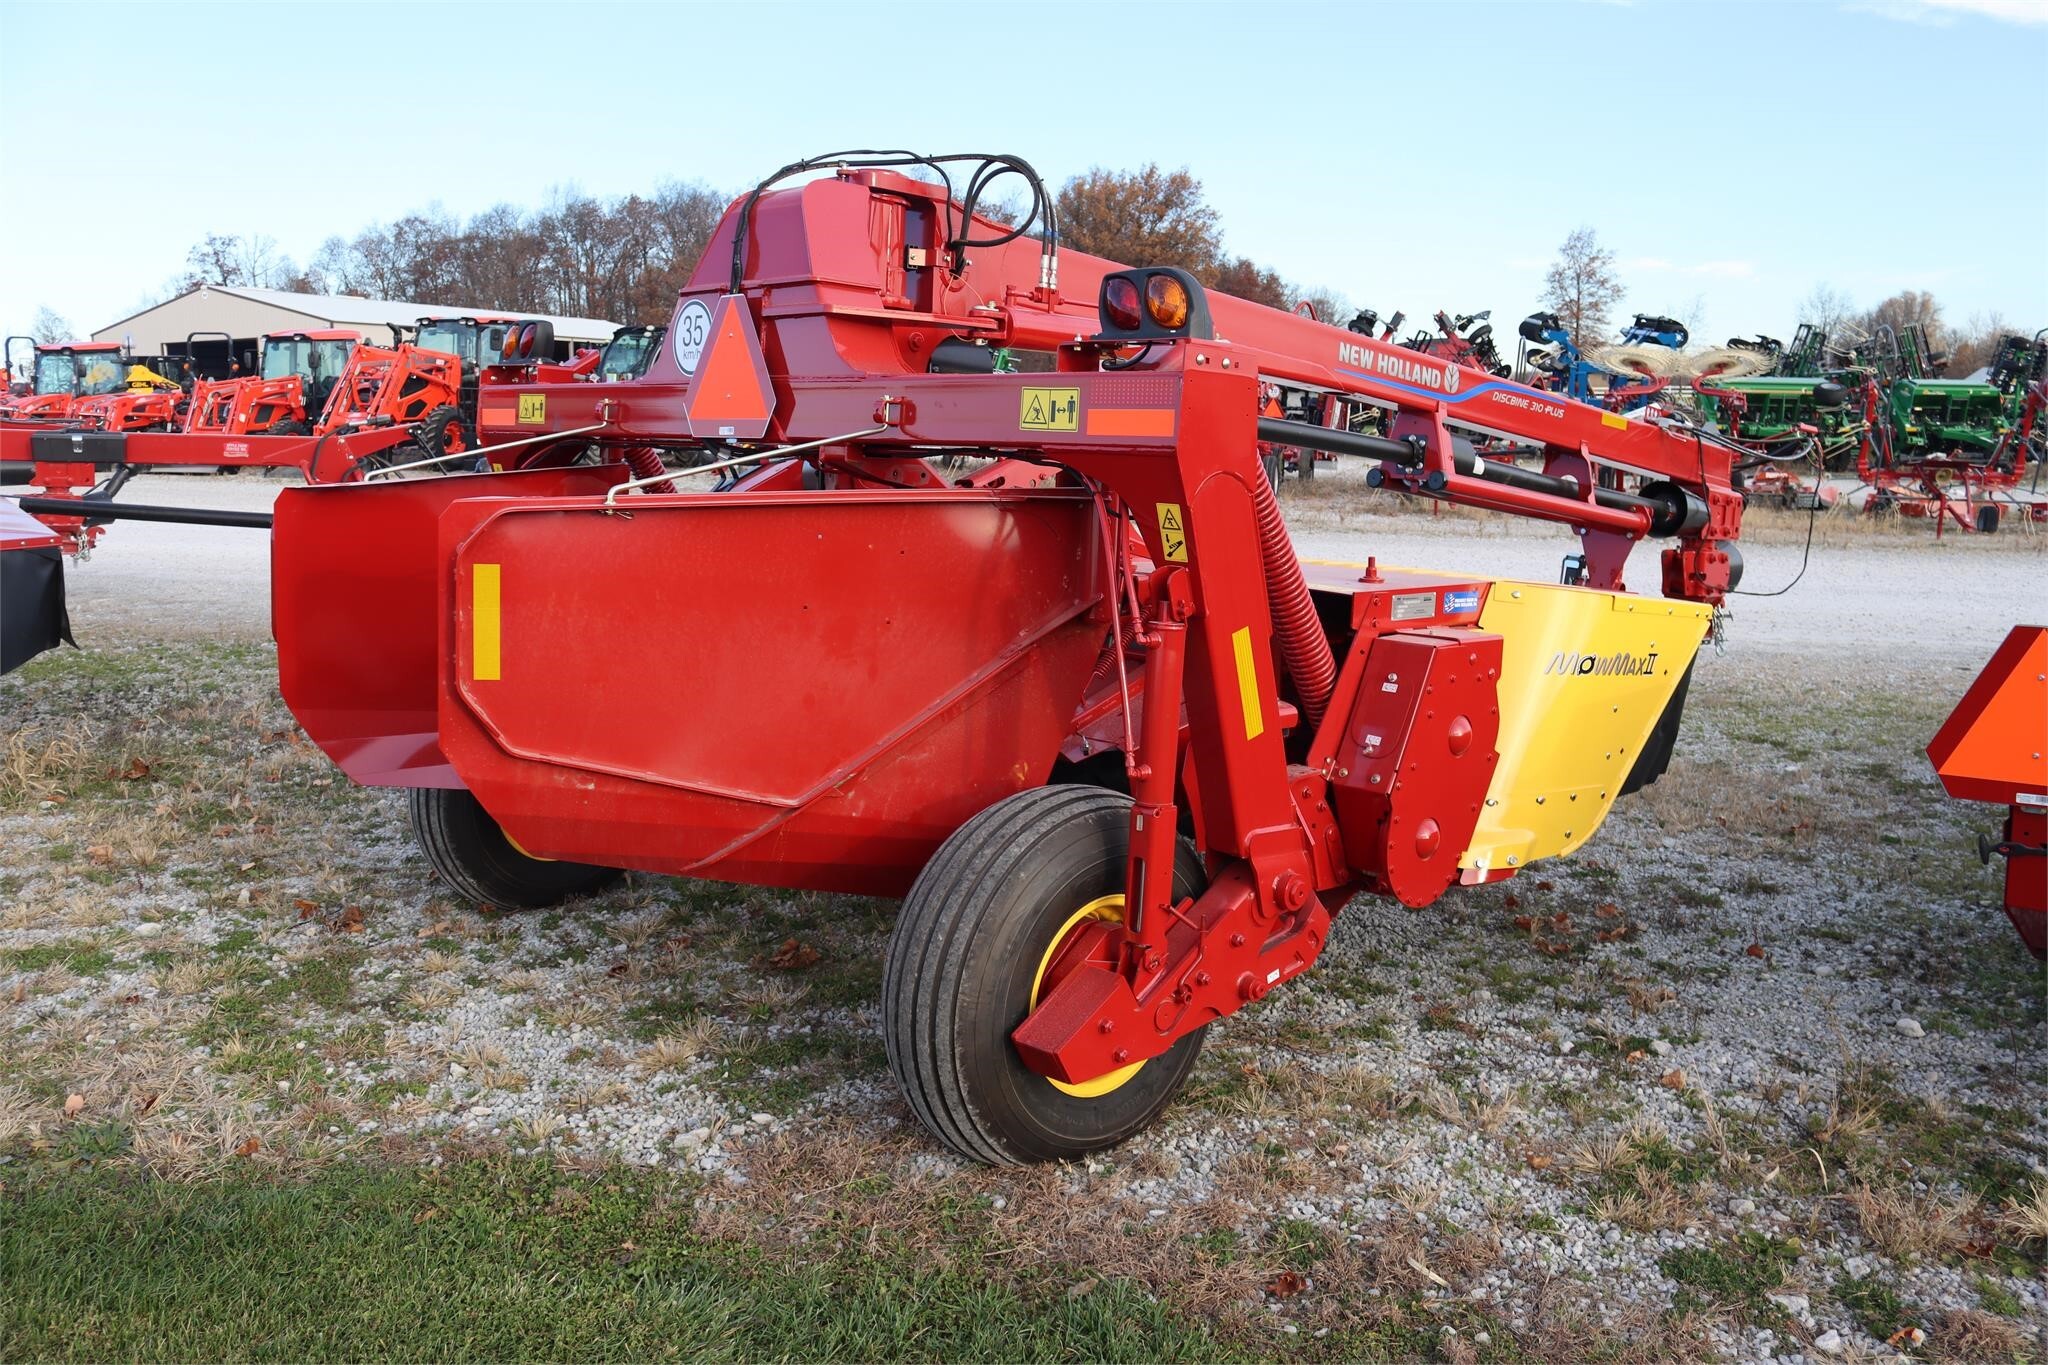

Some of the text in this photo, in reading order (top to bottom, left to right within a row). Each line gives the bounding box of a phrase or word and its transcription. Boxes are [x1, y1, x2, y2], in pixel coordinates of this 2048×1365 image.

[683, 315, 703, 347] 35
[1339, 342, 1442, 389] NEW HOLLAND
[1492, 391, 1530, 409] DISCBINE
[1530, 401, 1544, 413] 310
